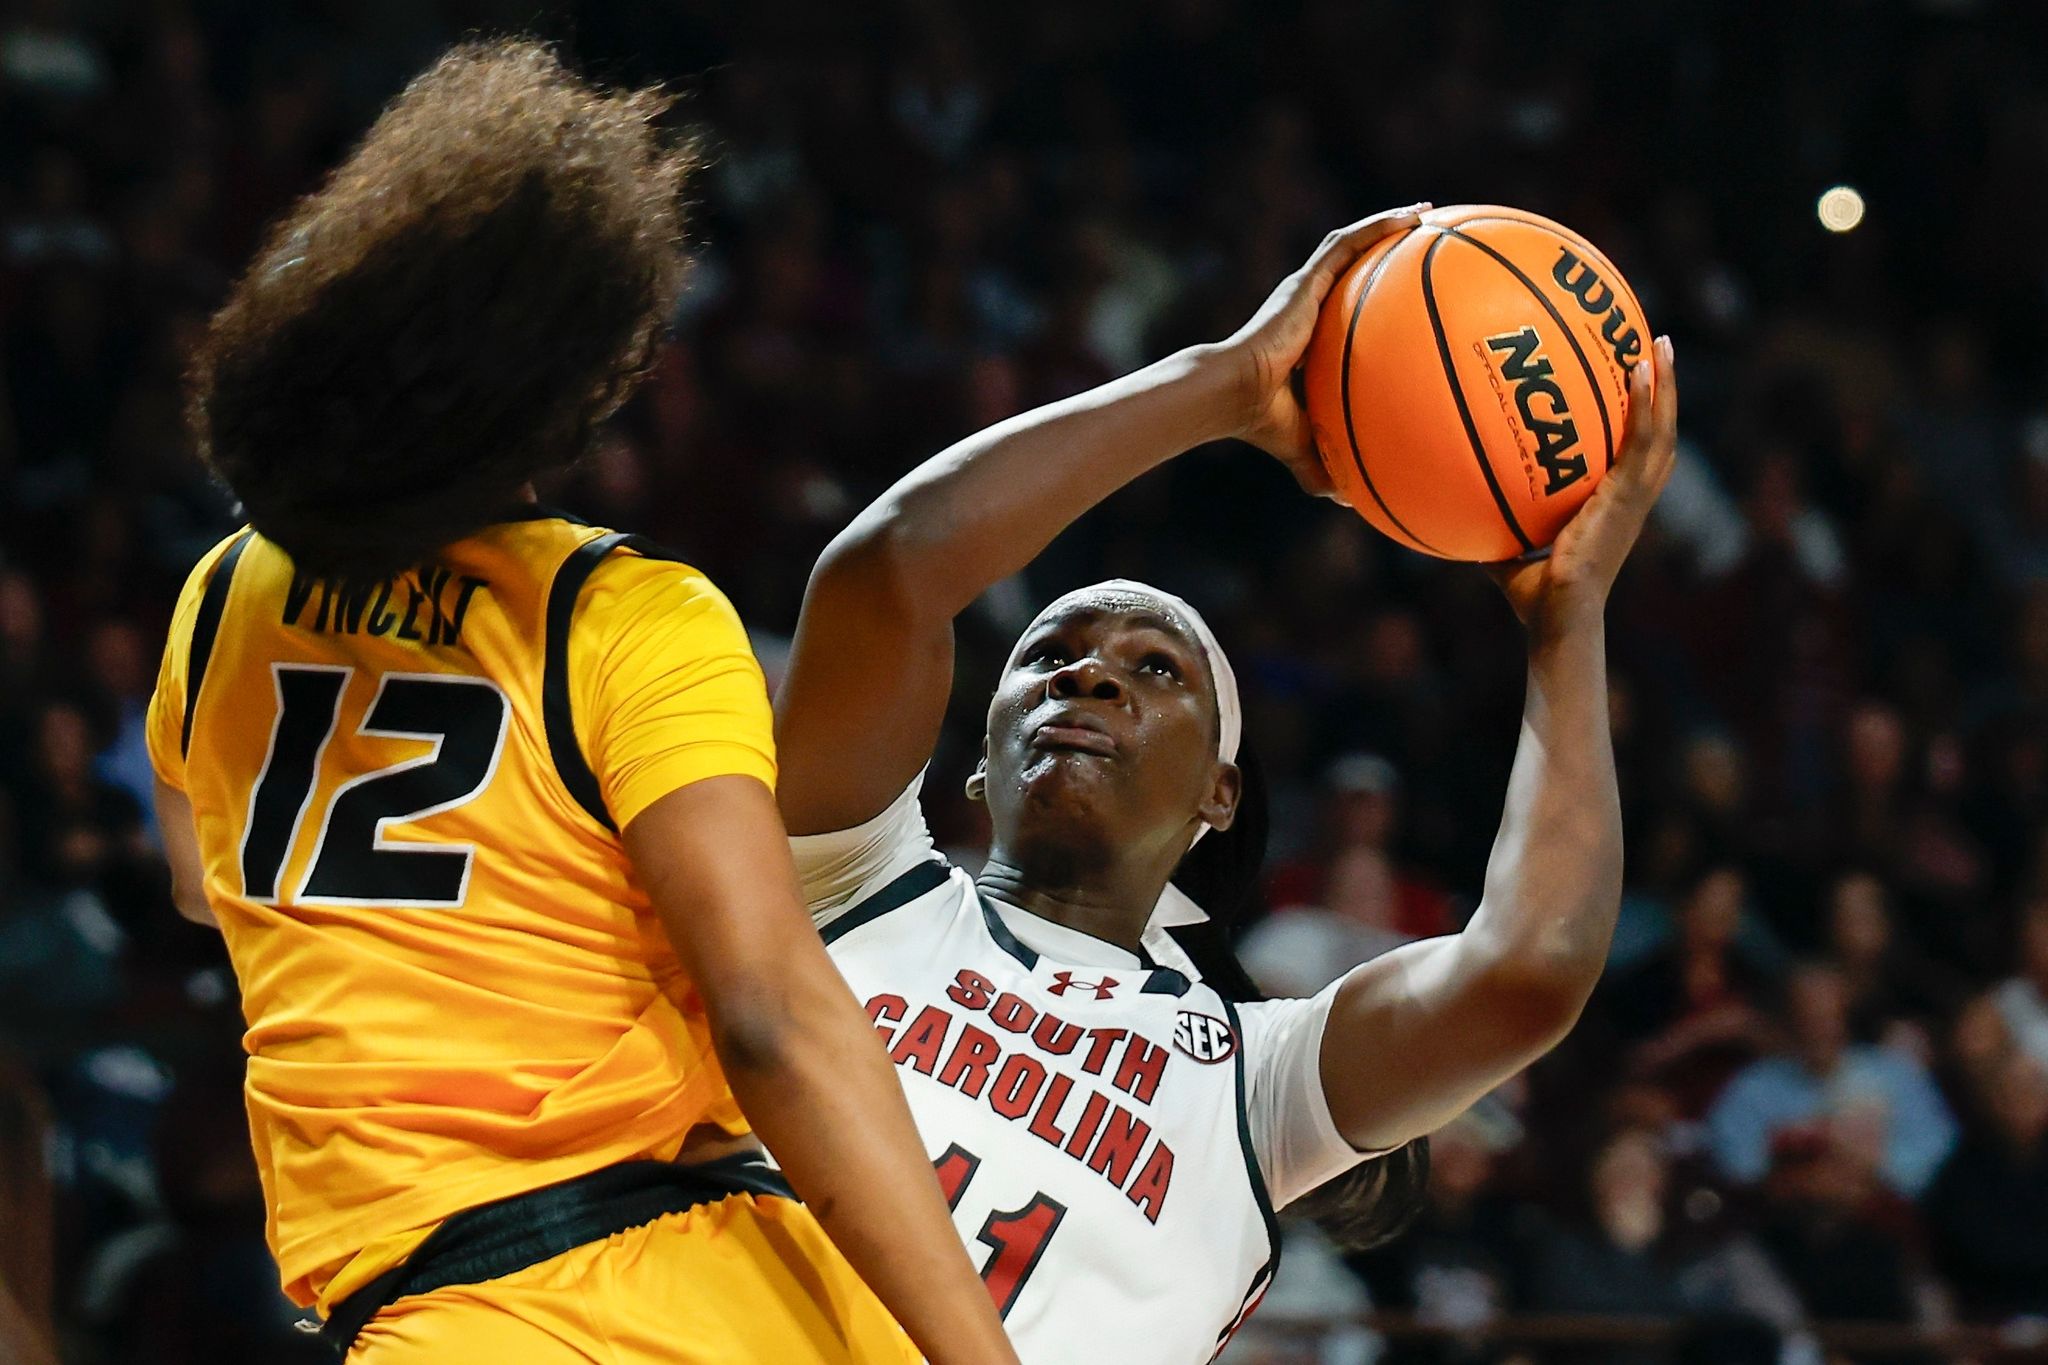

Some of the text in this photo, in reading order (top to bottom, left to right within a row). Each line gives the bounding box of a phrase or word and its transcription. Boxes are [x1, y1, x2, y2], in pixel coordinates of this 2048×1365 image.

[1552, 245, 1642, 393] Wil
[1472, 341, 1536, 502] OFFICIAL GAME BALL
[1485, 325, 1588, 497] NCAA
[282, 568, 490, 646] VINCENT
[239, 662, 513, 909] 12
[864, 993, 1175, 1226] CAROLINA
[945, 969, 1170, 1106] SOUTH
[1174, 1011, 1233, 1061] SEC
